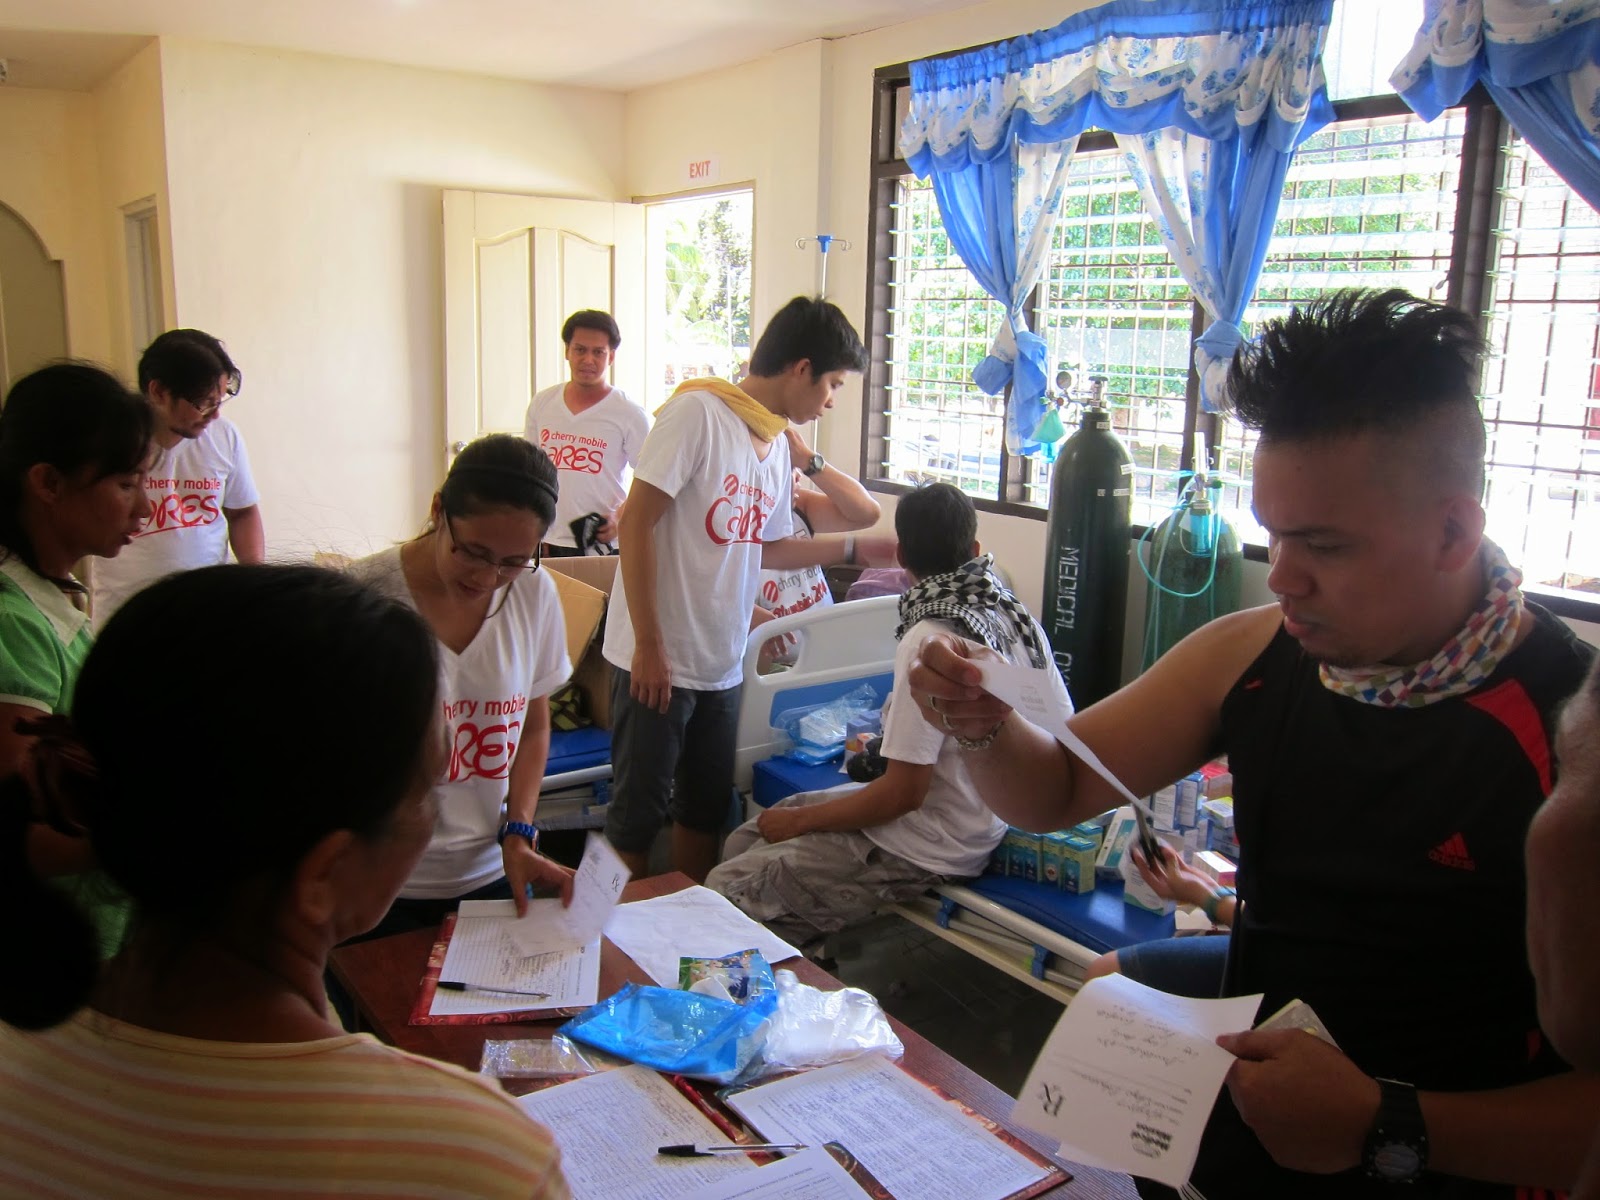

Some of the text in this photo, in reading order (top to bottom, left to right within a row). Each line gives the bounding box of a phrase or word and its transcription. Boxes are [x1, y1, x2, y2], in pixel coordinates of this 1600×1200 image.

[689, 160, 711, 179] EXIT
[551, 431, 608, 449] cherry mobile
[184, 477, 220, 490] mobile
[740, 481, 762, 502] chery
[778, 574, 801, 592] chrry
